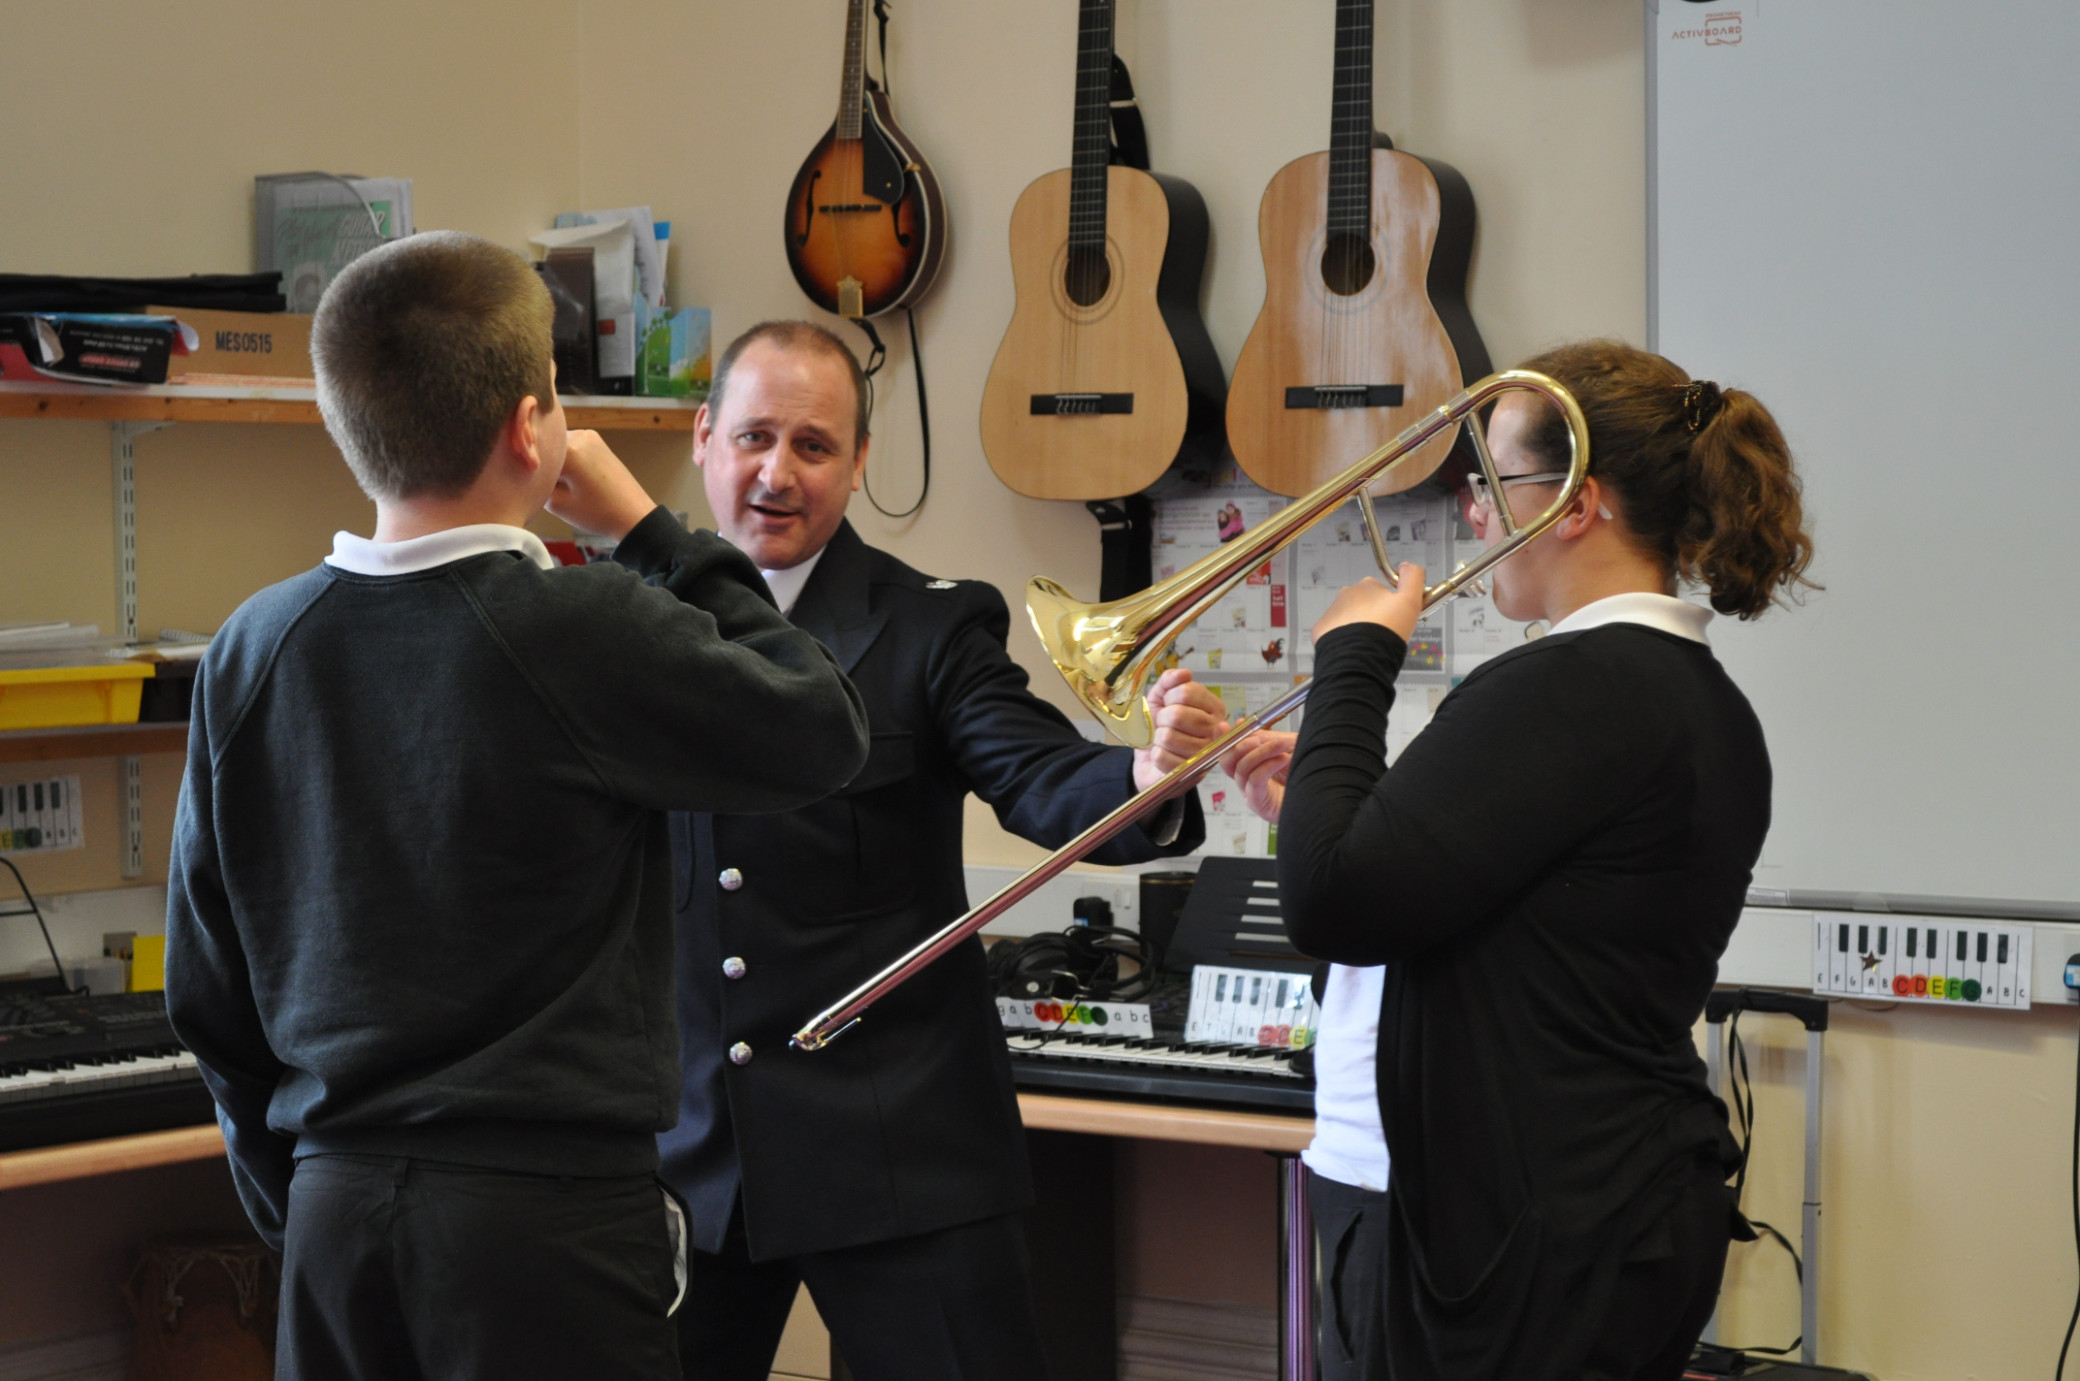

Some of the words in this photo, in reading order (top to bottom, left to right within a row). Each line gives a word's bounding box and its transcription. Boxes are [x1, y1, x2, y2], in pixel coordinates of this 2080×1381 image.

[1672, 26, 1742, 39] ACTIVBOARD
[1915, 977, 1927, 993] D
[1932, 979, 1943, 995] E
